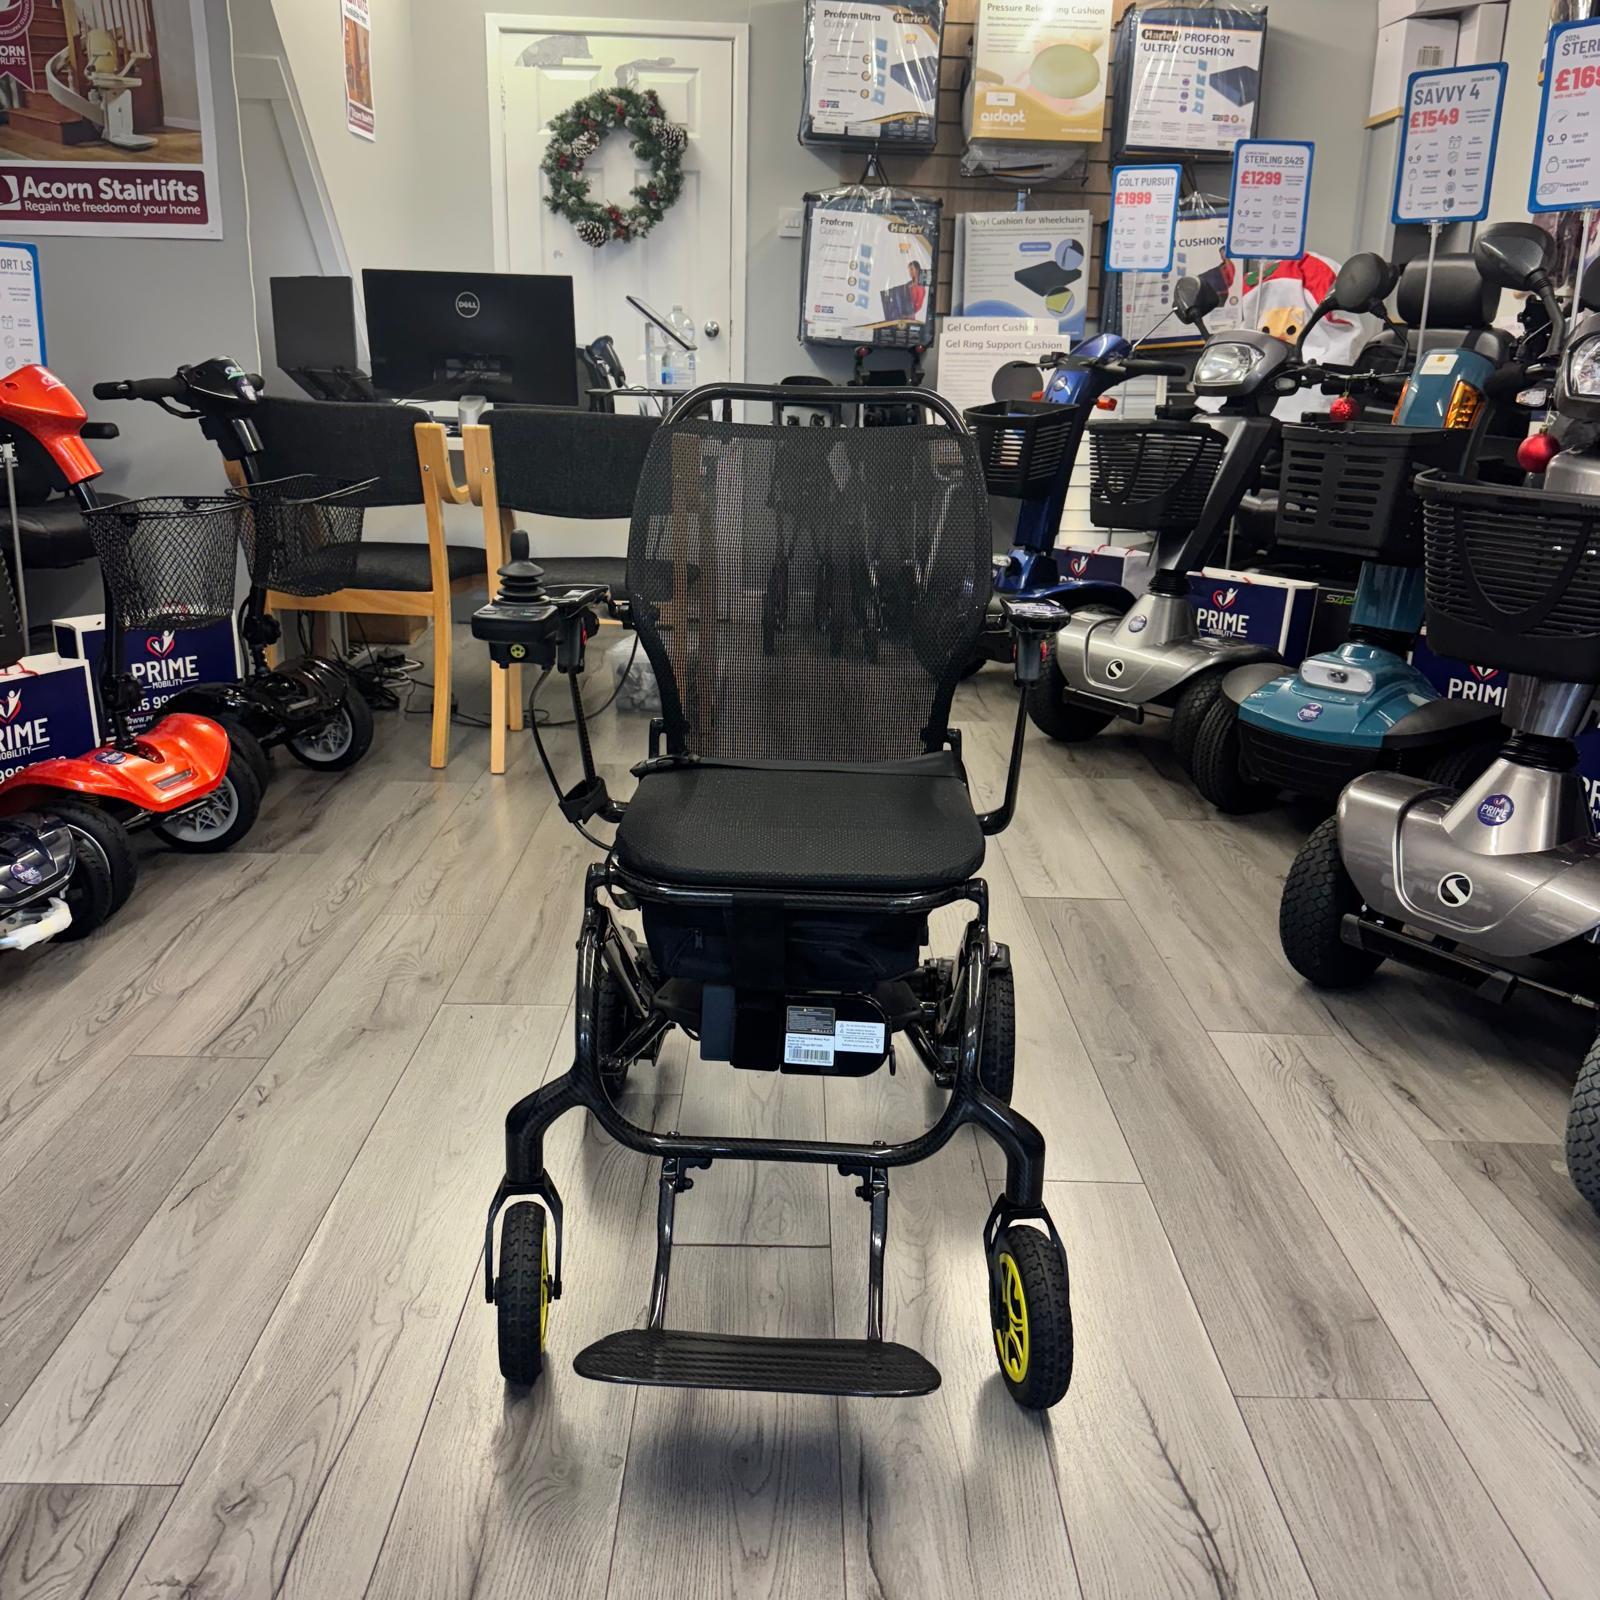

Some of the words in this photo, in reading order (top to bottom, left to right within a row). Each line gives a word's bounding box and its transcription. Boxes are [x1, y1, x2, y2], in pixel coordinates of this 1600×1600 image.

[823, 10, 859, 20] Proform
[860, 12, 881, 21] Ultra
[986, 3, 1024, 13] Pressure
[1025, 4, 1069, 15] Reling
[1071, 6, 1105, 15] Cushion
[0, 45, 26, 57] ORN
[1183, 45, 1235, 57] CUSHION
[1414, 84, 1466, 106] SAVVY
[1469, 83, 1480, 100] 4
[1409, 107, 1460, 129] £1549
[1244, 155, 1283, 165] STERLING
[1284, 156, 1305, 166] S425
[1119, 177, 1140, 187] COLT
[1141, 176, 1175, 186] PURSUIT
[1241, 170, 1282, 186] £1299
[23, 176, 94, 200] Acorn
[98, 177, 200, 202] Stairlifts
[1115, 191, 1152, 206] £1999
[24, 200, 61, 214] Regain
[63, 202, 81, 212] the
[83, 202, 128, 213] freedom
[129, 203, 142, 214] of
[143, 205, 168, 216] your
[169, 204, 201, 215] home
[820, 217, 854, 227] Proform
[991, 216, 1023, 226] Cushion
[1025, 215, 1037, 224] for
[1038, 215, 1085, 224] Wheelchairs
[1178, 236, 1225, 248] CUSHION
[0, 258, 18, 270] ORT
[20, 260, 32, 272] LS
[947, 323, 961, 332] Gel
[963, 322, 1000, 332] Comfort
[1002, 322, 1039, 332] Cushin
[945, 339, 961, 349] Gel
[963, 339, 984, 351] Ring
[985, 340, 1022, 351] Support
[1024, 340, 1063, 350] Cushion
[1196, 607, 1250, 634] PRIME
[131, 655, 200, 683] PRIME
[151, 678, 183, 689] MOBILITY
[1447, 677, 1508, 708] PRIM
[0, 745, 32, 761] OBILITY
[1480, 803, 1510, 820] PRIME
